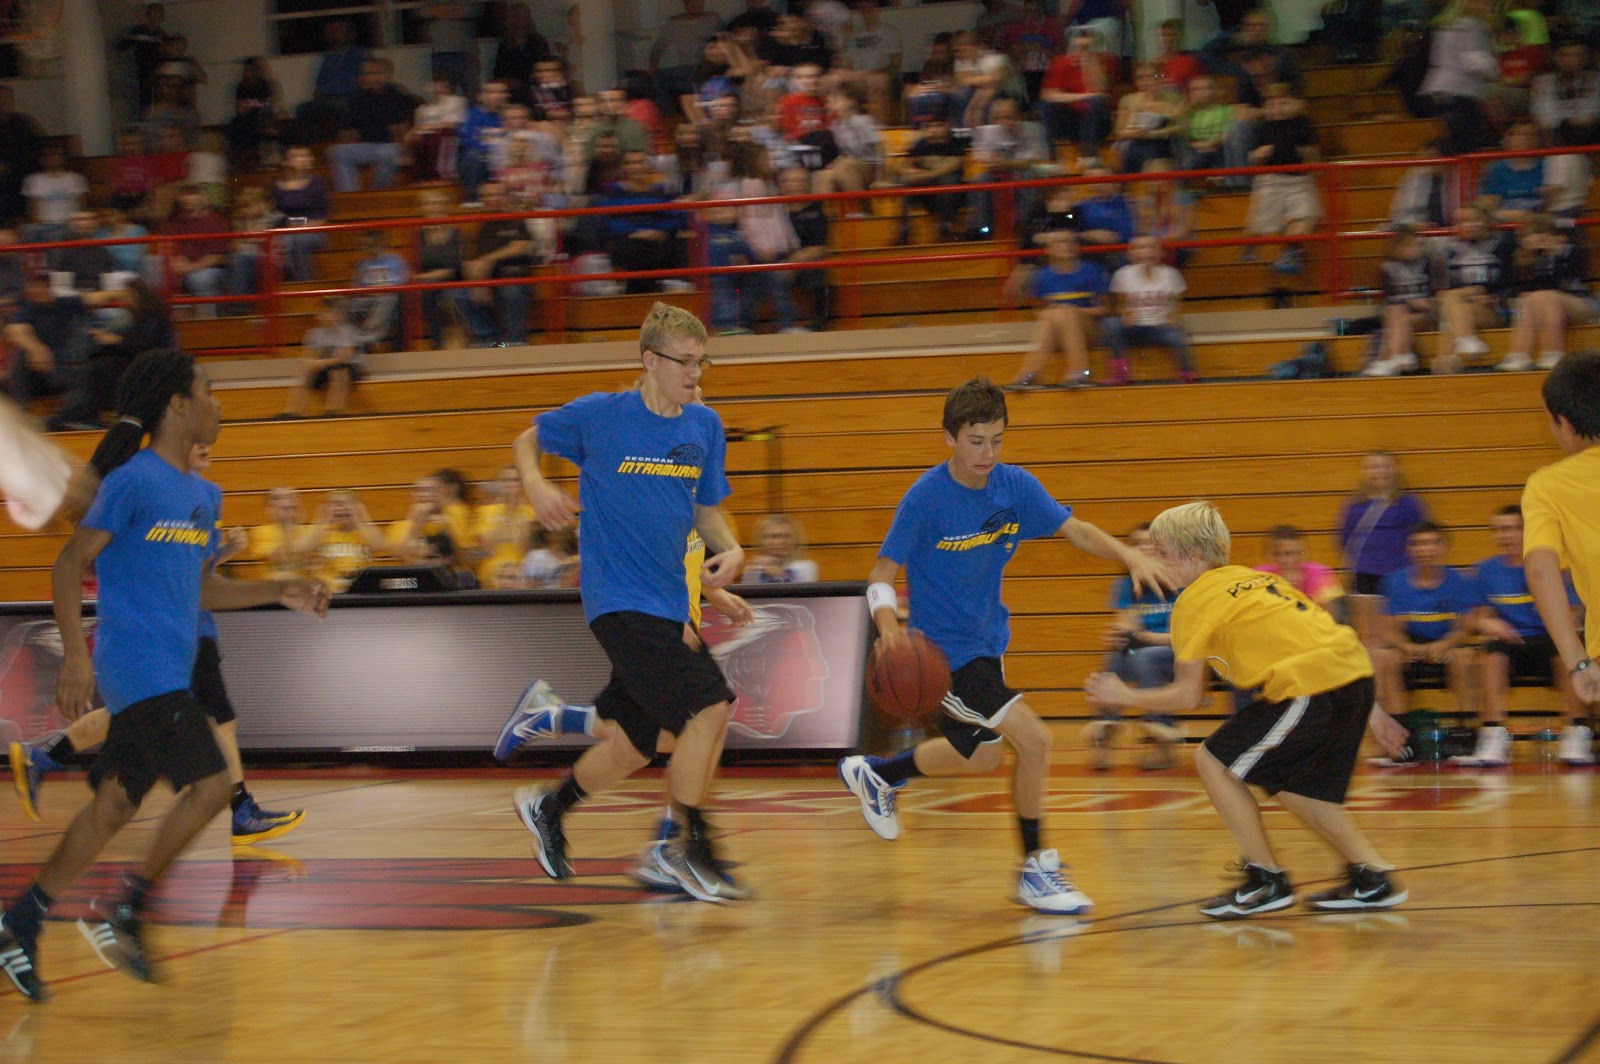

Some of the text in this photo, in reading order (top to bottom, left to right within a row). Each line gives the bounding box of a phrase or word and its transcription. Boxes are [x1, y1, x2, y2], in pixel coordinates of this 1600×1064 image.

[624, 455, 674, 464] BECKMAN
[617, 461, 703, 479] INTRAMURAL
[935, 522, 1020, 551] INTRAMULS
